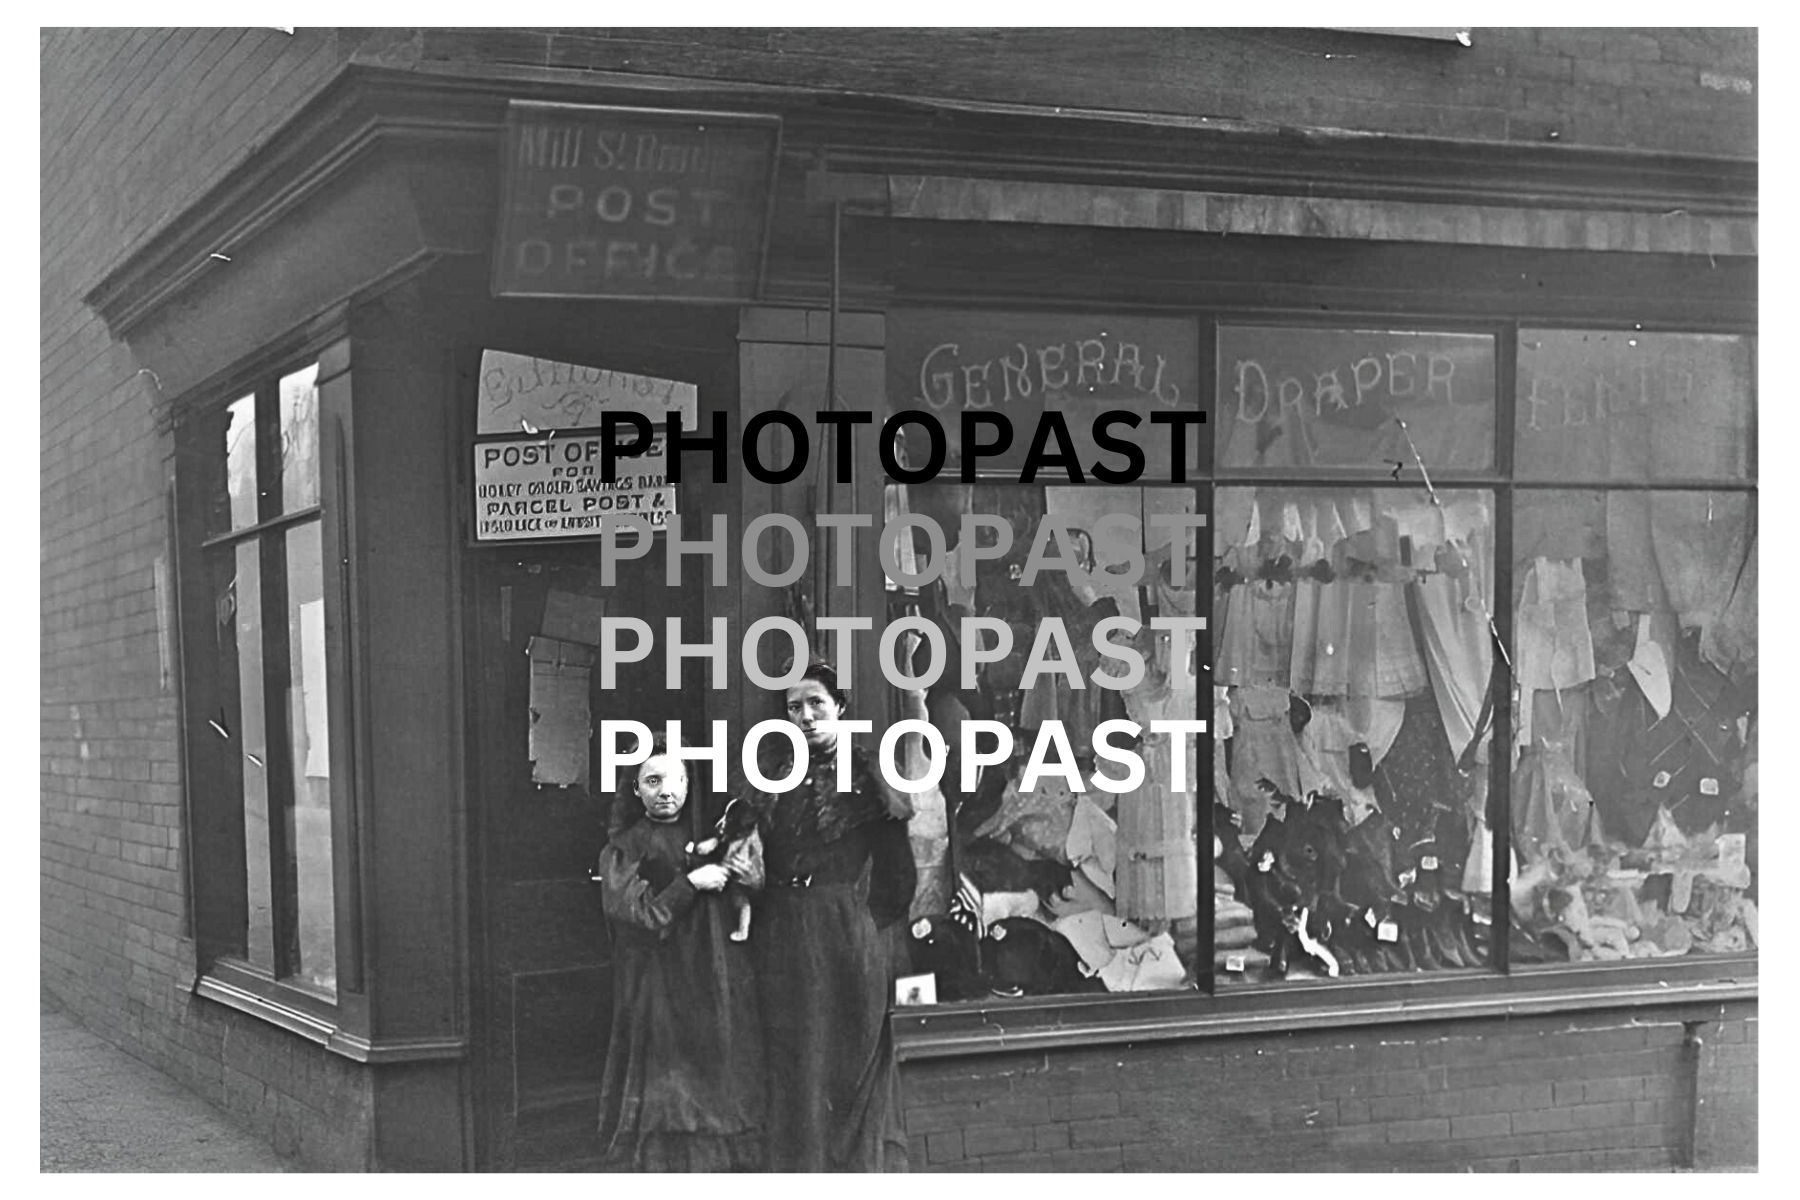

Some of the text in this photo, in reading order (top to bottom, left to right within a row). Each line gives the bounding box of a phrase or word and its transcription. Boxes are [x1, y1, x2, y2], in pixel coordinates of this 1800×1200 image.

[547, 184, 733, 227] POST
[516, 238, 738, 281] OFFICE
[920, 338, 1180, 410] GENERAL
[1234, 351, 1456, 423] DRAPER
[484, 437, 663, 469] POST OFE
[486, 499, 573, 516] PARCEL
[583, 494, 644, 511] POST
